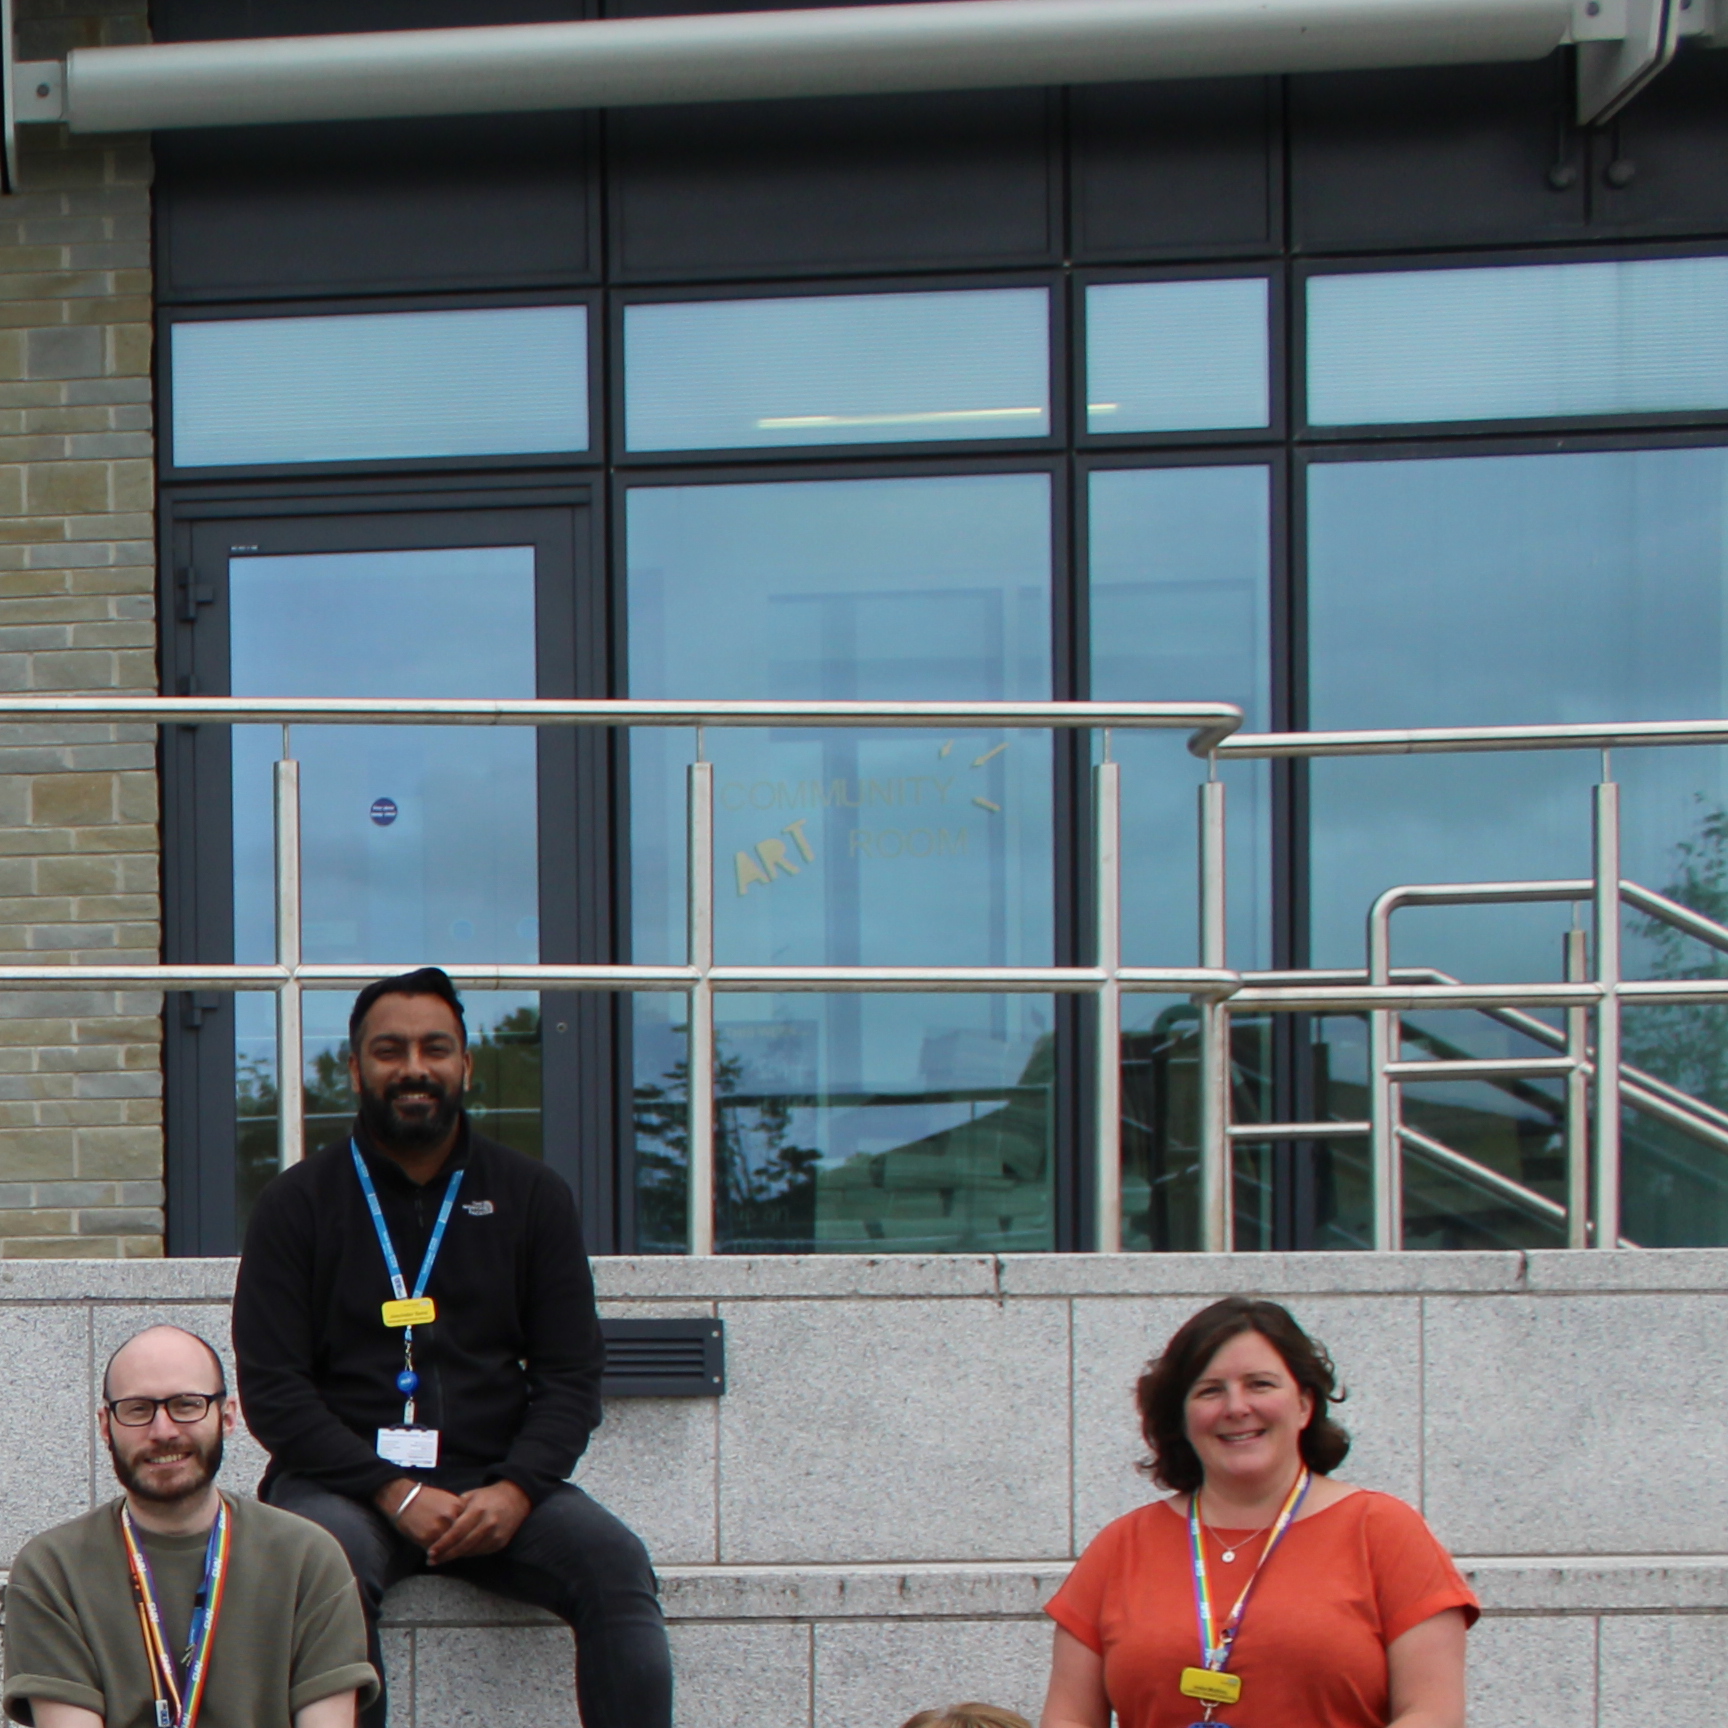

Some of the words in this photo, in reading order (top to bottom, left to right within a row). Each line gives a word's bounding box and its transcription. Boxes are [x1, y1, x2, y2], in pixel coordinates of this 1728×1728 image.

[720, 776, 956, 812] COMMUNITY
[733, 818, 815, 897] ART
[849, 827, 969, 859] ROOM
[133, 1553, 147, 1572] NHS
[212, 1556, 223, 1578] NHS
[146, 1602, 159, 1622] NHS
[204, 1608, 214, 1630] NHS
[192, 1660, 203, 1682] NHS
